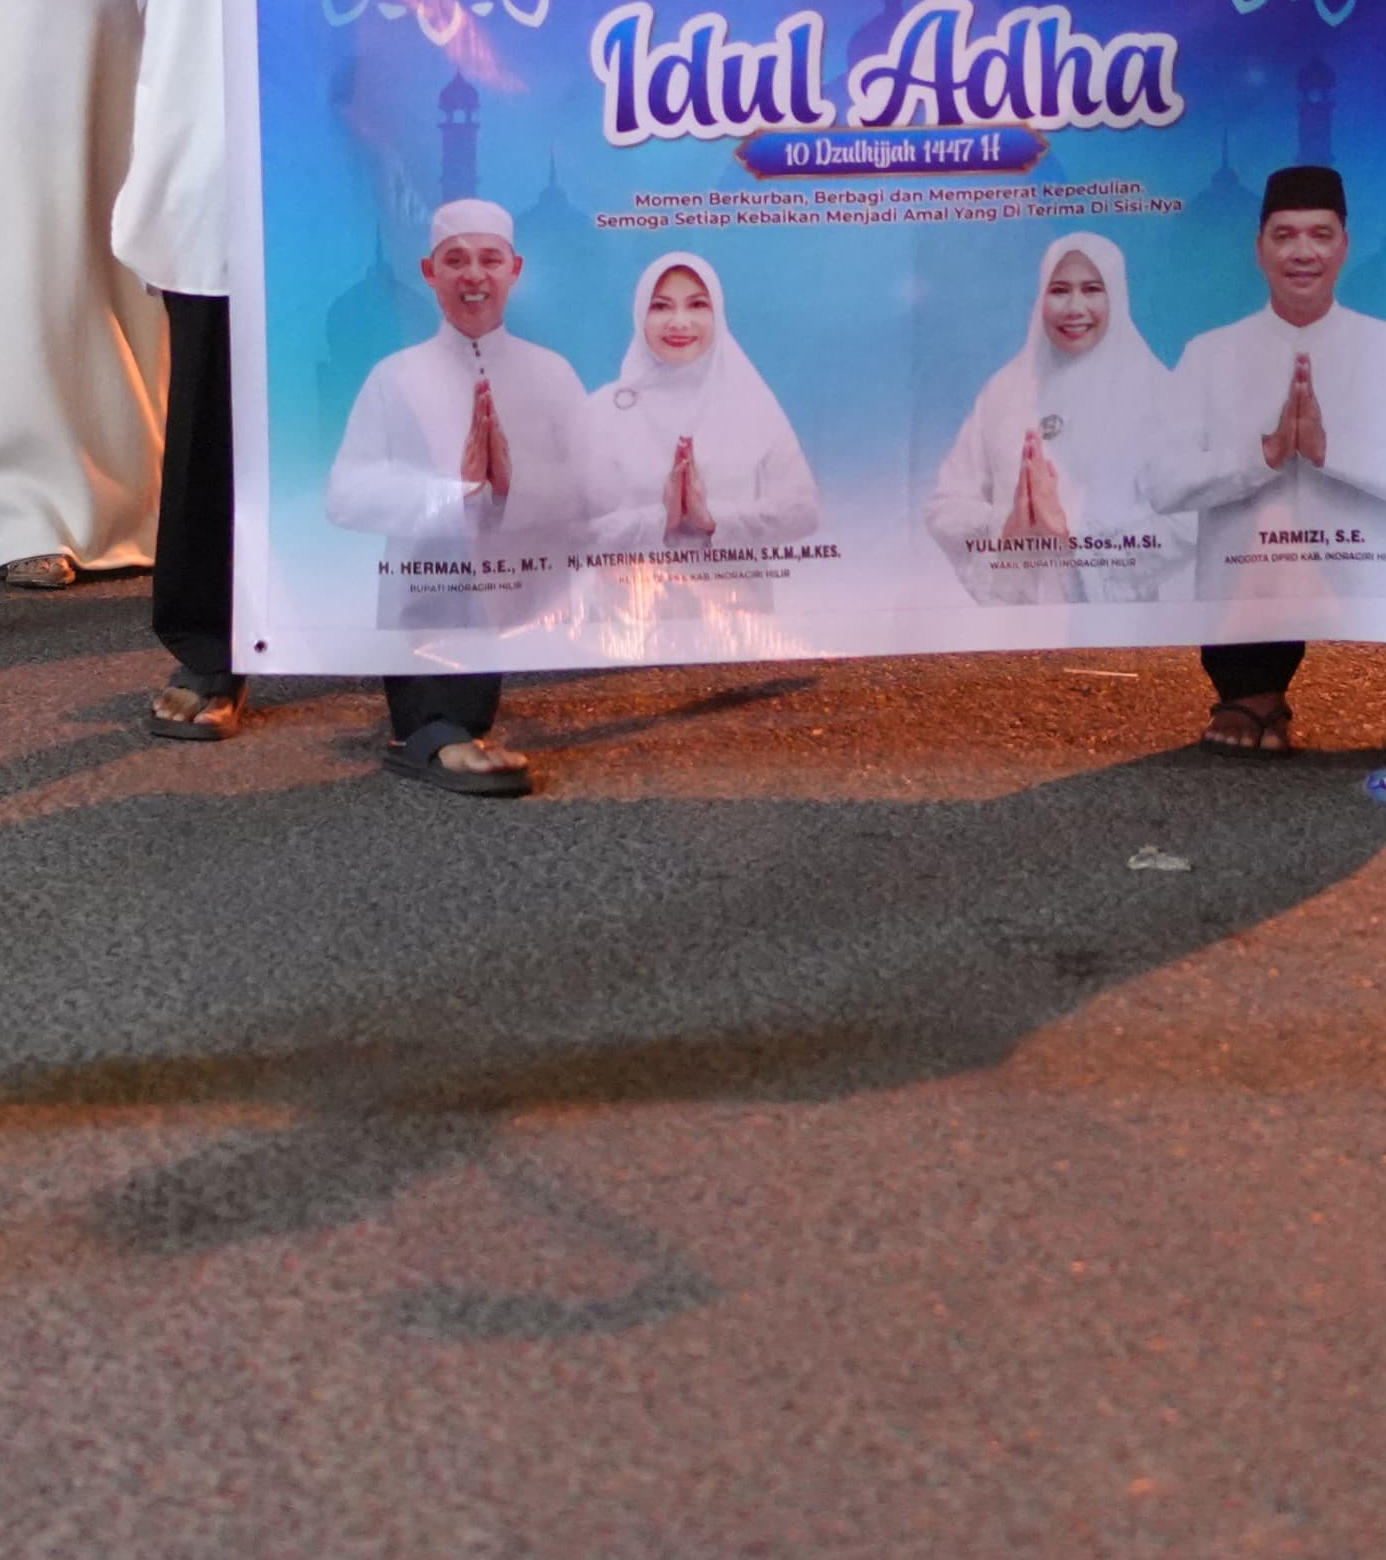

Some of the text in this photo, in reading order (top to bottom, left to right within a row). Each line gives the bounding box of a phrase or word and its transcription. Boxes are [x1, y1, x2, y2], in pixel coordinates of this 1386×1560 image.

[599, 2, 1176, 136] Idul Adha
[786, 135, 1000, 168] 10 Dzulhijjah 1447 H
[635, 192, 705, 207] Momen
[709, 190, 808, 207] Berkurban,
[815, 189, 884, 207] Berbagi
[889, 187, 925, 203] dan
[929, 184, 1038, 204] Mempererat
[596, 197, 1183, 231] Semoga Setiap Kebaikan Menjadi Amal Yang Di Terima Di Sisi-Nya
[1259, 529, 1365, 546] TARMIZI, S.E.
[378, 557, 552, 576] H. HERMAN, S.E., M.T.
[567, 555, 583, 571] Hj.
[586, 552, 645, 568] KATERINA
[649, 550, 700, 565] SUSANTI
[703, 548, 758, 563] HERMAN,
